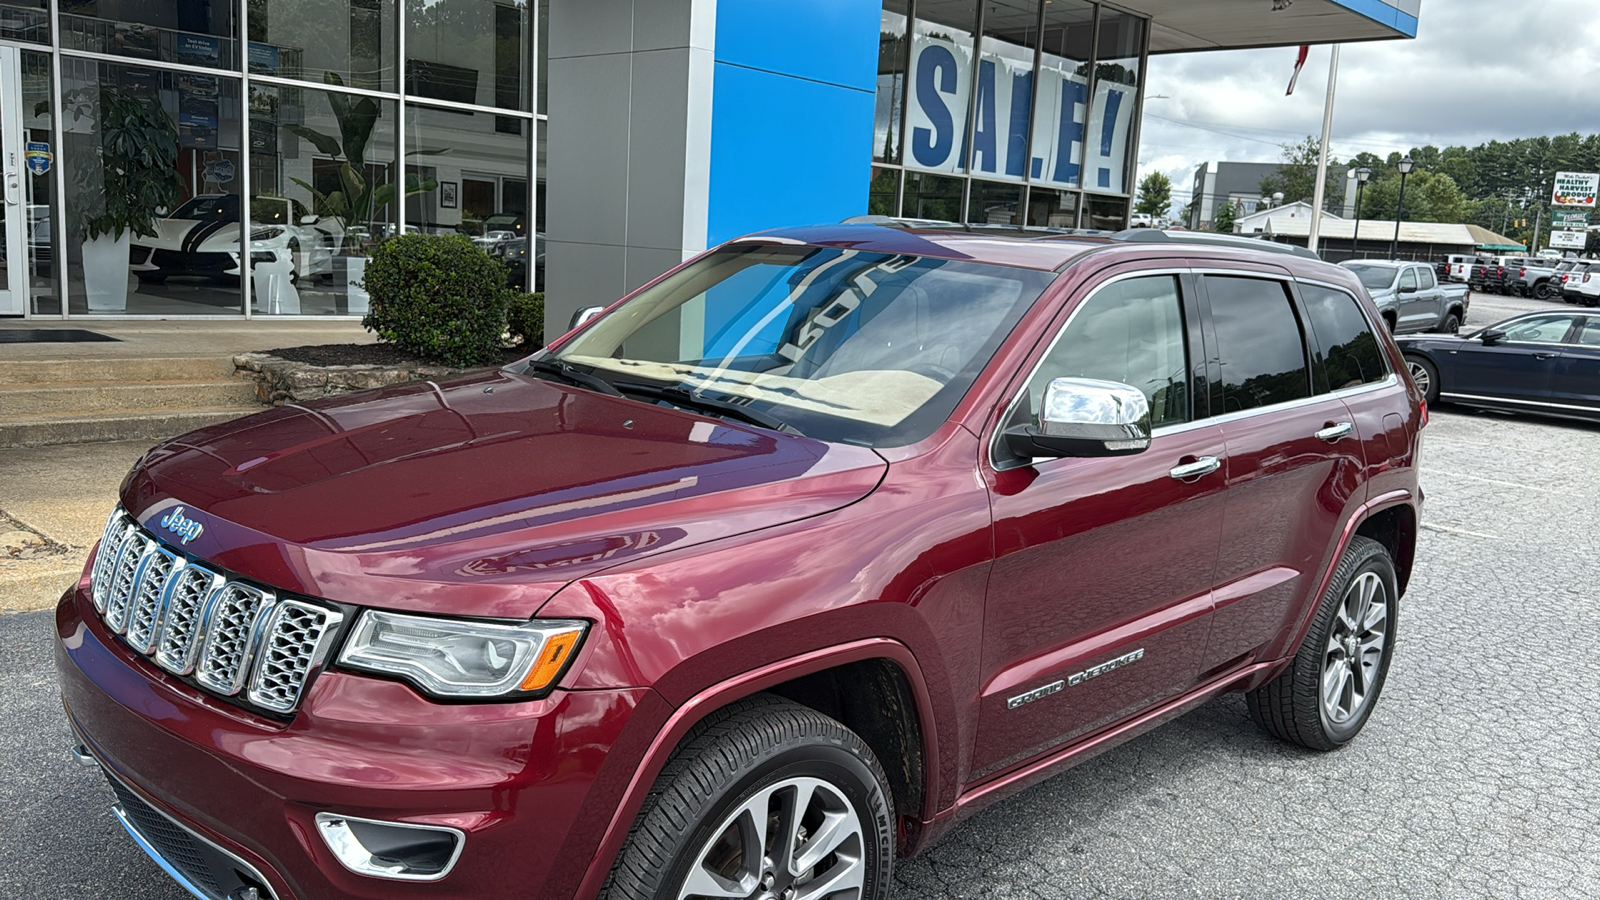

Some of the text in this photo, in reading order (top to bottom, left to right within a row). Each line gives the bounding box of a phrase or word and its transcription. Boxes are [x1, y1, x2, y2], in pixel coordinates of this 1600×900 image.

[912, 45, 1123, 188] SALE!
[161, 506, 204, 546] Jeep
[1007, 648, 1145, 710] GRAND CHEROKEE
